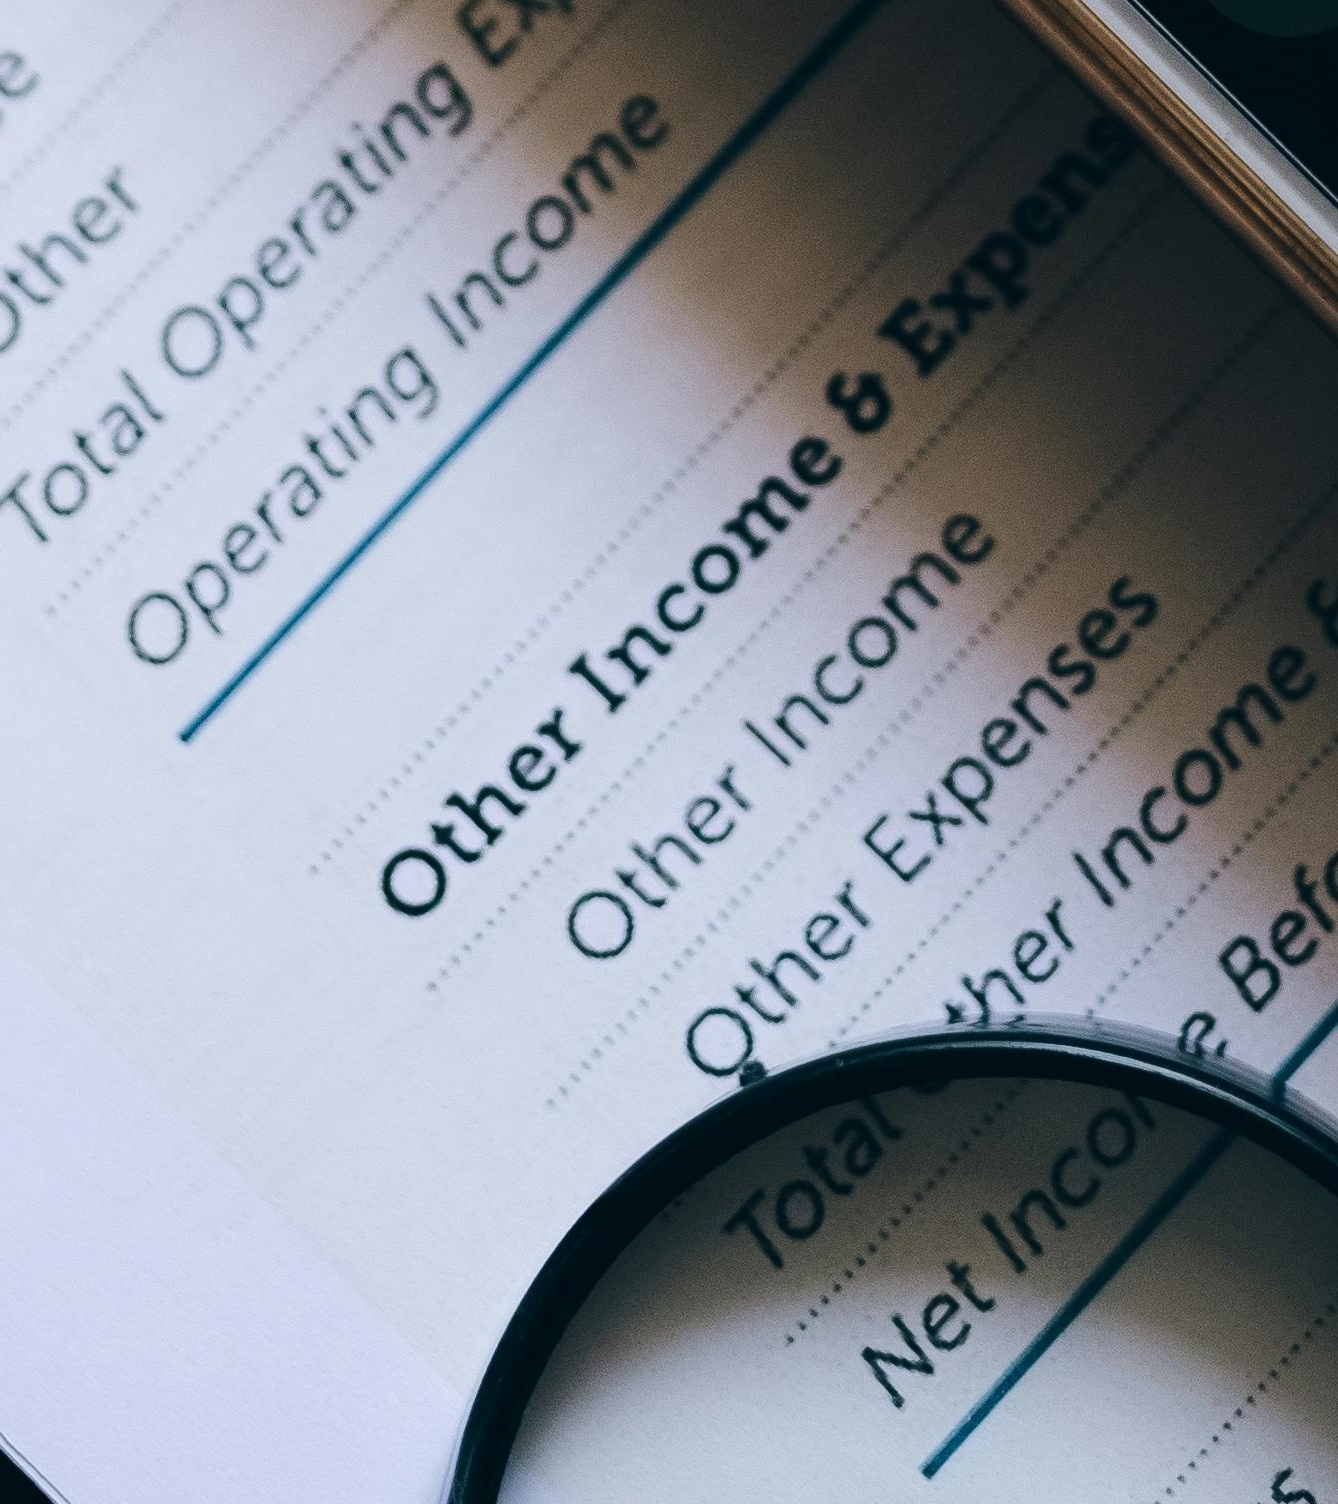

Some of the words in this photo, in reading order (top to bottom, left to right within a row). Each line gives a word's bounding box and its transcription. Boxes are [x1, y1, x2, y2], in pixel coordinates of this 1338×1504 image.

[126, 339, 443, 669] Operating
[424, 89, 674, 352] Income
[159, 58, 473, 382] Operating
[380, 705, 583, 917] Other
[568, 431, 847, 714] Income
[824, 374, 894, 436] &
[877, 115, 1139, 378] Expens
[566, 765, 755, 960] Other
[742, 509, 997, 769] Income
[683, 878, 873, 1080] Other
[861, 572, 1161, 884] Expenses
[721, 1091, 905, 1270] Total
[915, 899, 1078, 1068] ther
[1072, 641, 1321, 908] Income
[860, 1259, 997, 1410] Net
